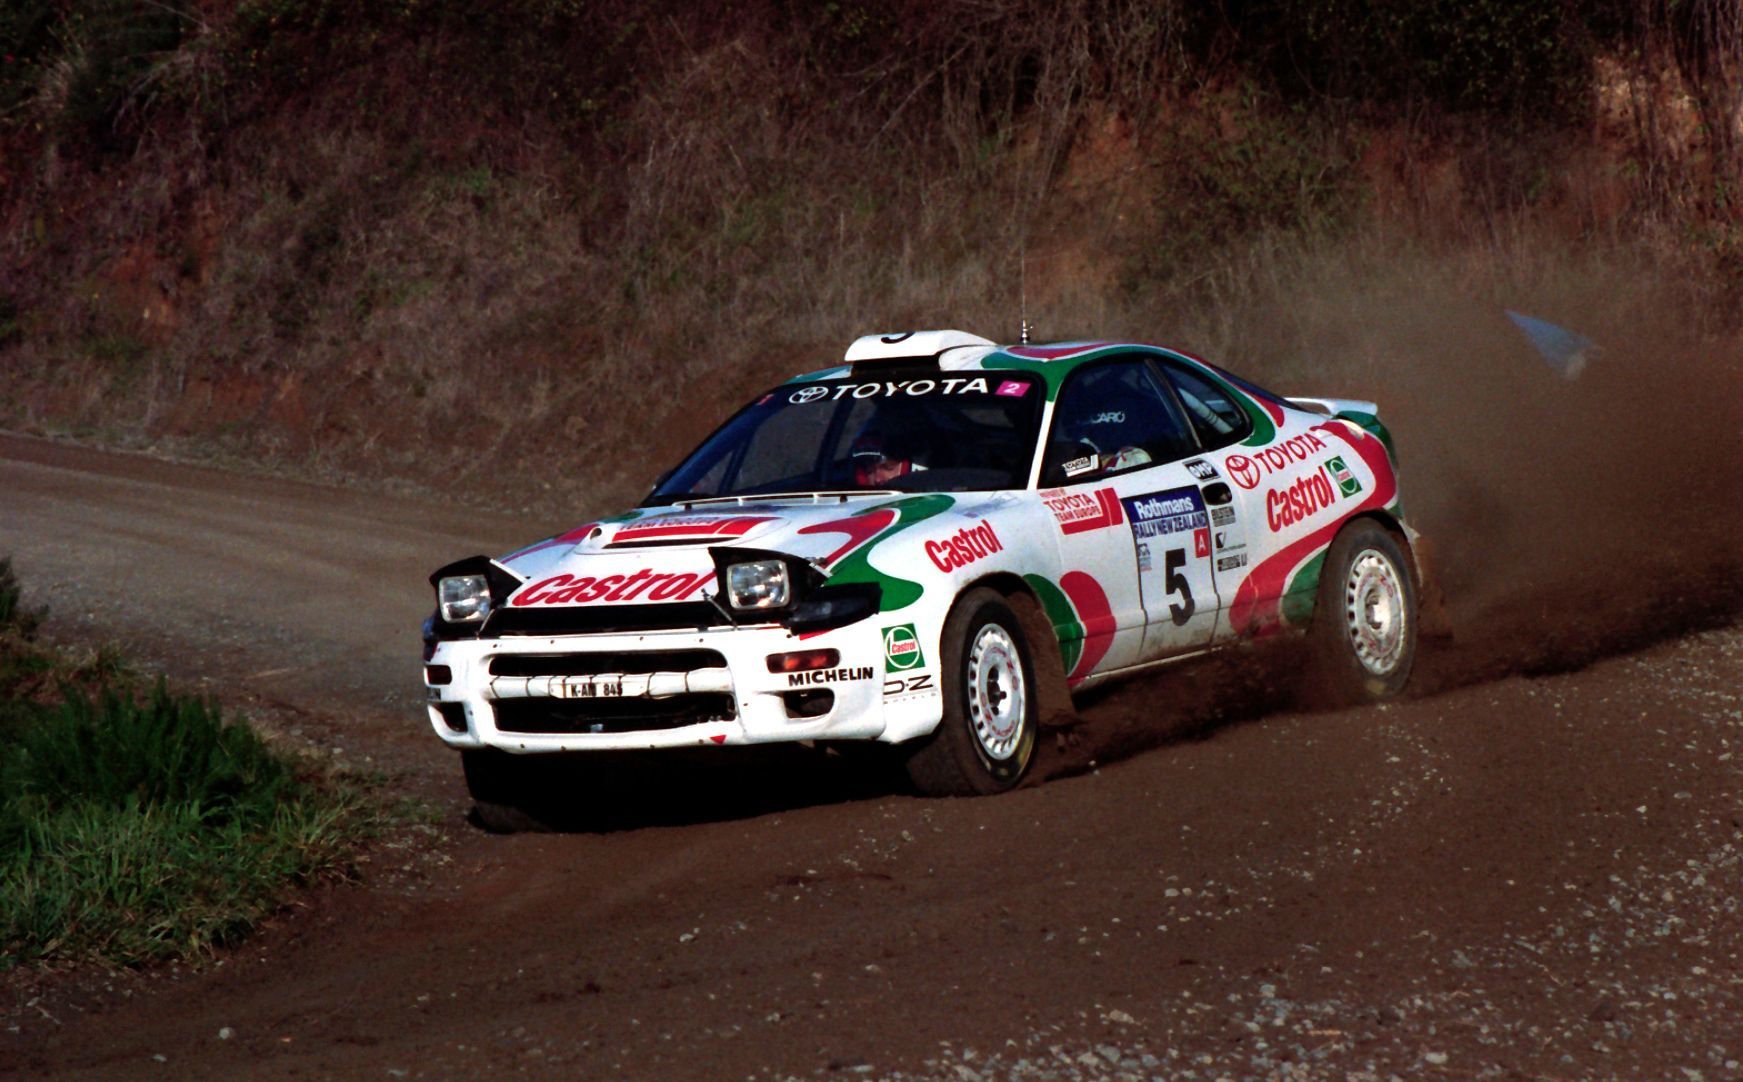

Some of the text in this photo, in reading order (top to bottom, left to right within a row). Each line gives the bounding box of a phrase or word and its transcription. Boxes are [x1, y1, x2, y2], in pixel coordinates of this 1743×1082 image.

[832, 378, 989, 400] TOYOTA
[1004, 383, 1021, 394] 2
[1253, 433, 1327, 474] TOYOTA
[1043, 494, 1096, 512] TOYOTA
[1133, 497, 1194, 519] Rothmans
[1267, 466, 1335, 533] Castrol
[1133, 521, 1157, 539] RALLY
[1156, 517, 1174, 535] NEW
[1173, 512, 1207, 532] ZEALAND
[925, 519, 1003, 573] Castrol
[1198, 535, 1207, 552] A
[512, 568, 716, 606] Castrol
[1165, 548, 1195, 626] 5
[891, 640, 916, 654] Castrol
[788, 667, 874, 687] MICHELIN
